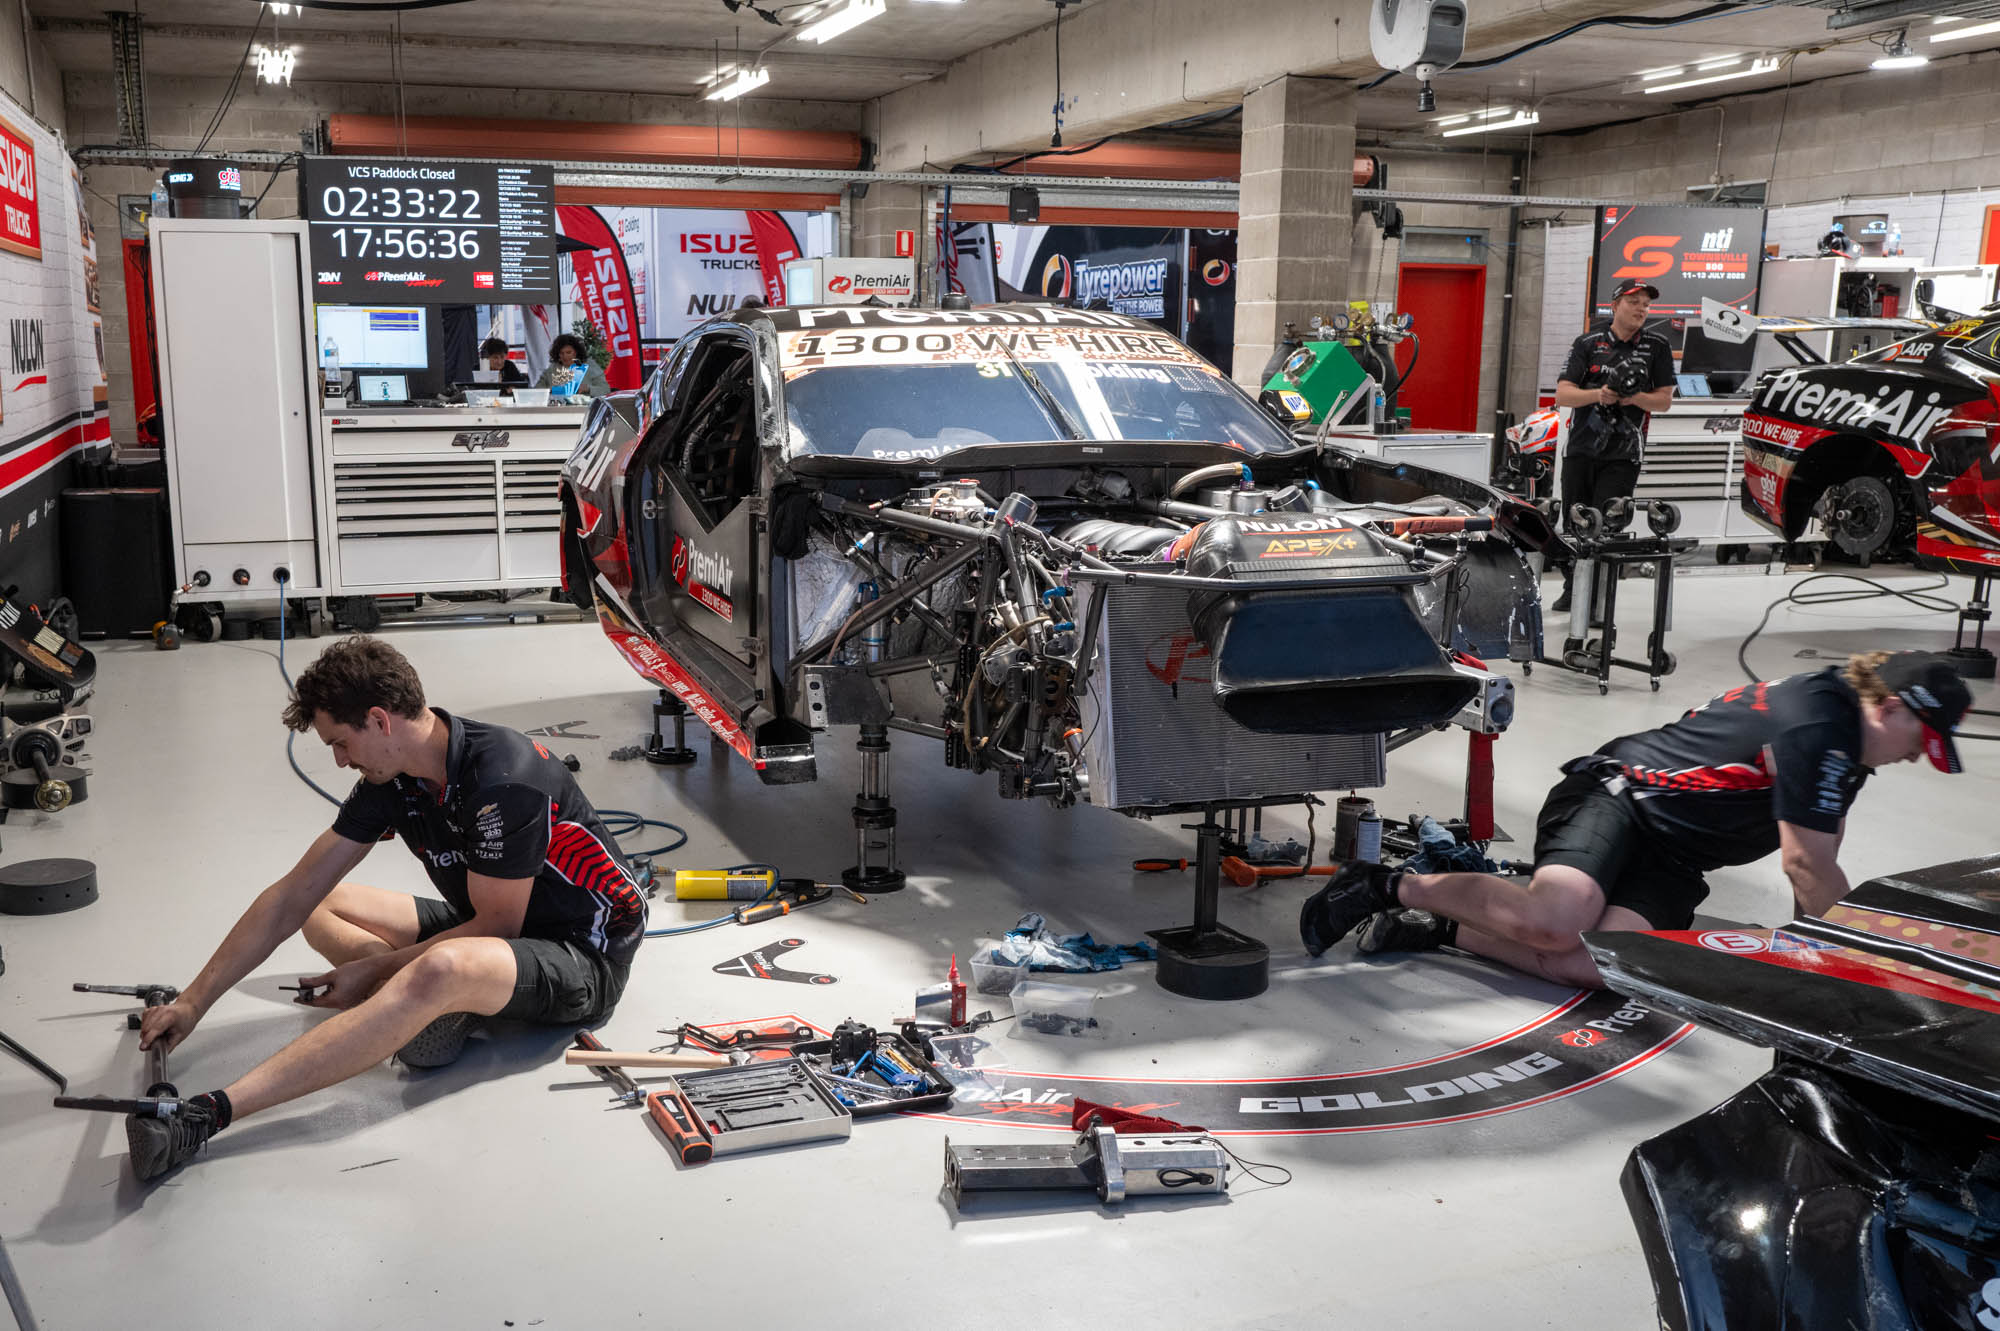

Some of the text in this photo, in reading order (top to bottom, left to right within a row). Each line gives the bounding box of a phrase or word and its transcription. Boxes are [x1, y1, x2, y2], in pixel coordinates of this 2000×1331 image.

[0, 133, 35, 201] SUZU
[348, 166, 455, 181] VCS Paddock Closed
[323, 186, 482, 219] 02:33:22
[4, 203, 32, 239] TRUCKS
[331, 227, 480, 259] 17:56:36
[680, 233, 759, 254] ISUZ
[1701, 227, 1734, 250] nti
[700, 259, 761, 270] TRUCKS
[1682, 251, 1749, 262] TOWNSVILLE
[853, 274, 912, 288] PremiAir
[1074, 258, 1167, 310] Tyrepower
[1707, 271, 1726, 279] JULY
[591, 247, 633, 358] ISUZU
[1114, 299, 1164, 313] GET THE POWER
[10, 318, 45, 375] NULON
[794, 333, 1188, 358] 1300 WE HIRE
[1076, 362, 1172, 384] olding
[1762, 368, 1953, 444] PremiAir
[1763, 422, 1782, 439] WE
[1779, 426, 1804, 444] HIRE
[1236, 517, 1345, 534] NULON
[1265, 534, 1358, 557] APEX+
[688, 537, 734, 597] PremiAir
[1584, 998, 1650, 1033] Prem
[1239, 1052, 1564, 1114] GOLDING
